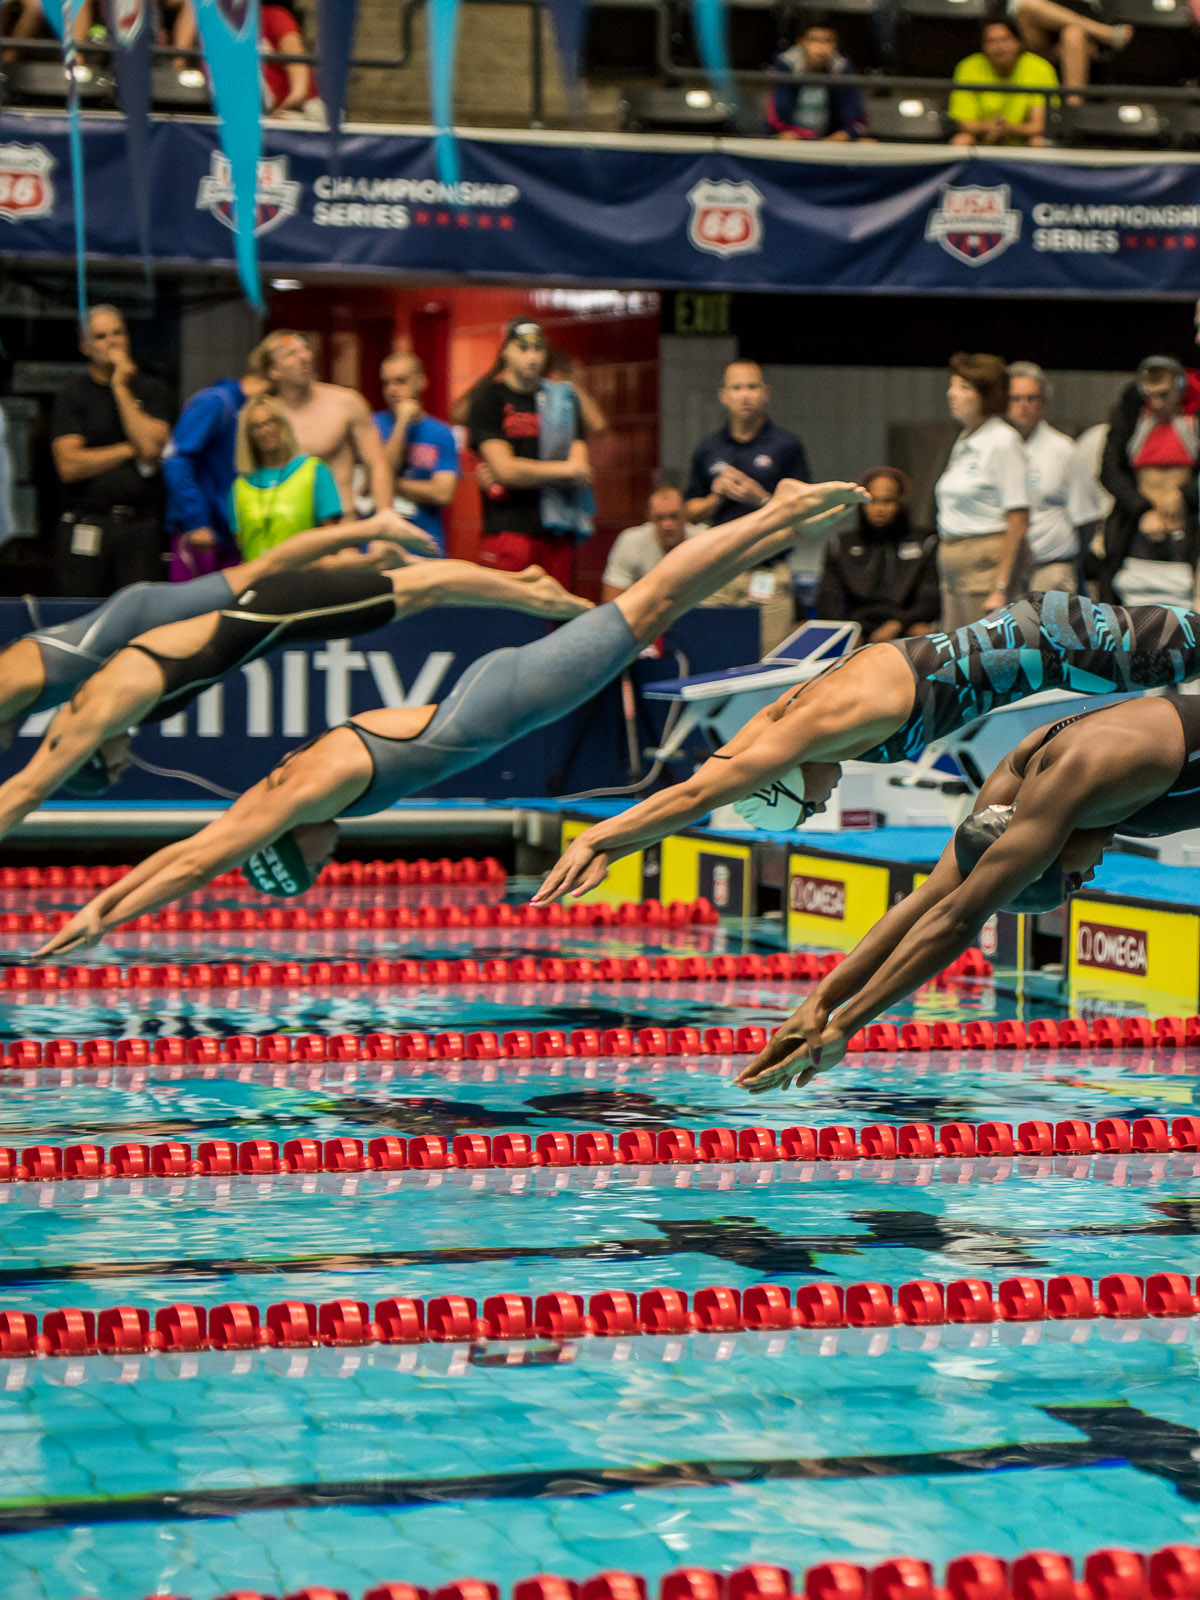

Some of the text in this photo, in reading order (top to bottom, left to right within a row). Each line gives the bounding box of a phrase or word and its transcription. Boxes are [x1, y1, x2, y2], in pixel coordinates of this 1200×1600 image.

[312, 175, 520, 208] CHAMPIONSHIP
[312, 201, 411, 229] SERIES
[1032, 229, 1120, 253] SERIES
[1093, 930, 1146, 969] OMEGA
